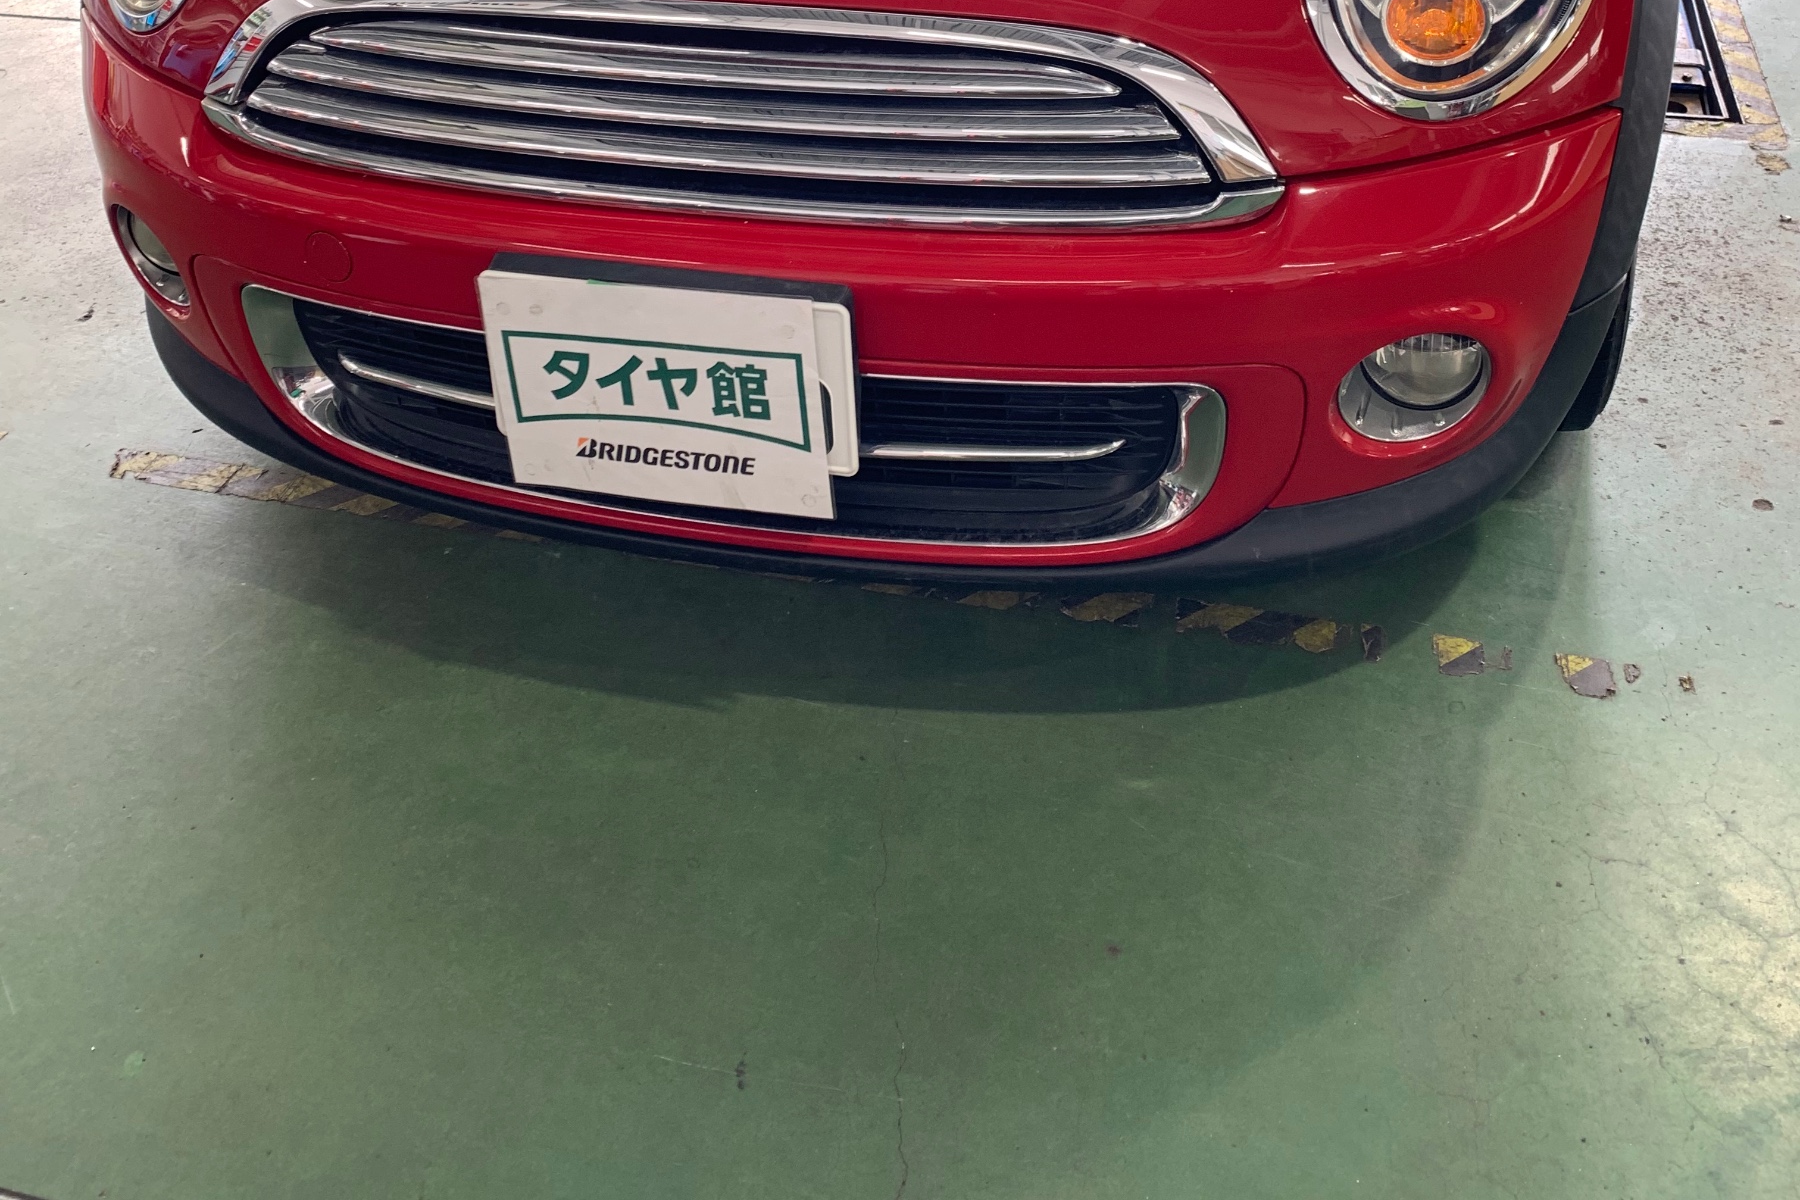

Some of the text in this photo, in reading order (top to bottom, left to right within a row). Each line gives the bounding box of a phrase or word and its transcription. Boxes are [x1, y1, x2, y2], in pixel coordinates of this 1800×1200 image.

[542, 350, 772, 421] タイヤ館
[575, 437, 756, 476] BRIDGESTONE
